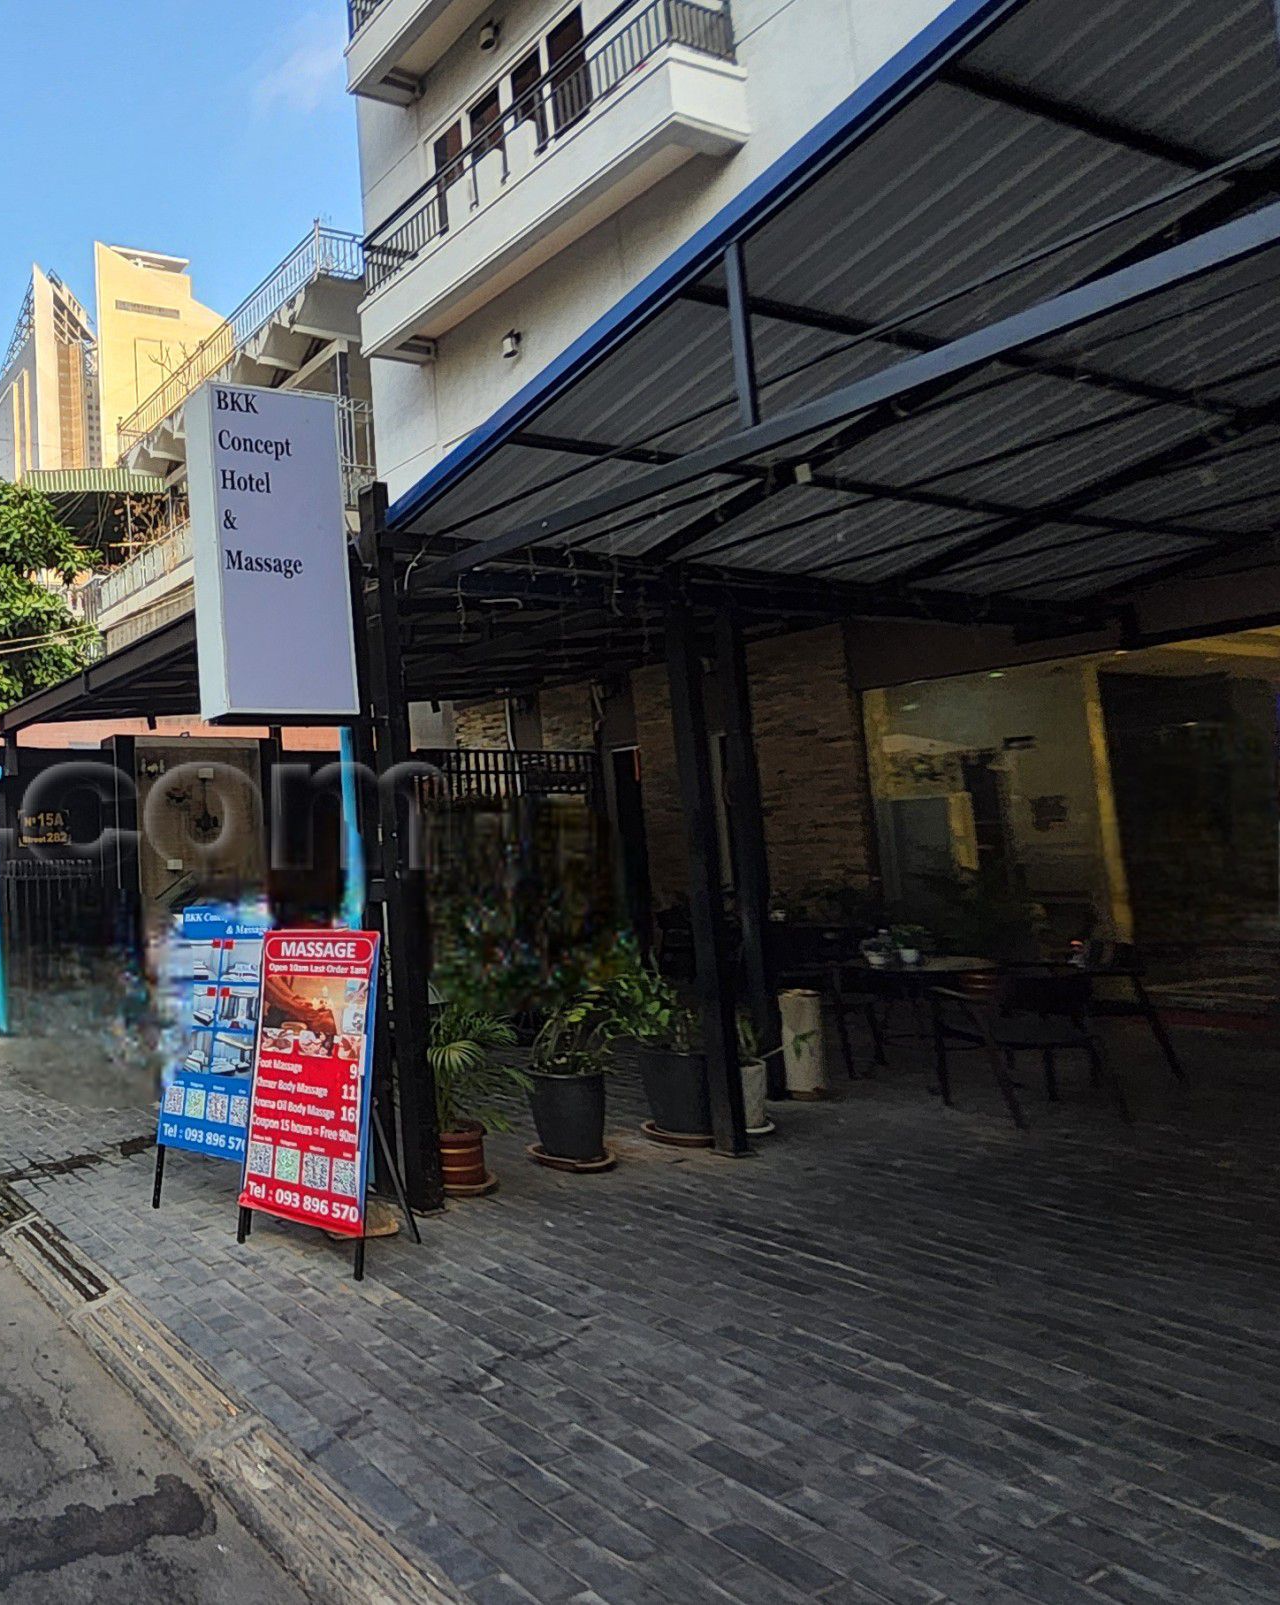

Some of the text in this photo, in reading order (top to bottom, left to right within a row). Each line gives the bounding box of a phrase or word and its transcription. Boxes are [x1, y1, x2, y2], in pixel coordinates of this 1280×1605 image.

[216, 390, 259, 414] BKK
[218, 429, 292, 460] Concept
[220, 469, 271, 493] Hotel
[223, 509, 238, 531] &
[225, 550, 303, 578] Massage
[37, 812, 64, 827] 15A
[46, 831, 67, 843] 282
[281, 942, 357, 958] MASSAGE
[269, 963, 288, 972] Open
[273, 1060, 302, 1074] Massage
[278, 1080, 296, 1094] Body
[297, 1082, 328, 1098] Massage
[341, 1084, 356, 1100] 11
[287, 1101, 306, 1116] Body
[340, 1106, 356, 1122] 16
[163, 1123, 177, 1138] Tel
[184, 1127, 204, 1144] 093
[205, 1131, 226, 1148] 896
[280, 1118, 290, 1131] 15
[291, 1120, 312, 1136] hours
[320, 1126, 338, 1140] Free
[248, 1181, 266, 1199] Tel
[275, 1188, 300, 1208] 093
[302, 1195, 329, 1215] 896
[331, 1202, 359, 1223] 570
